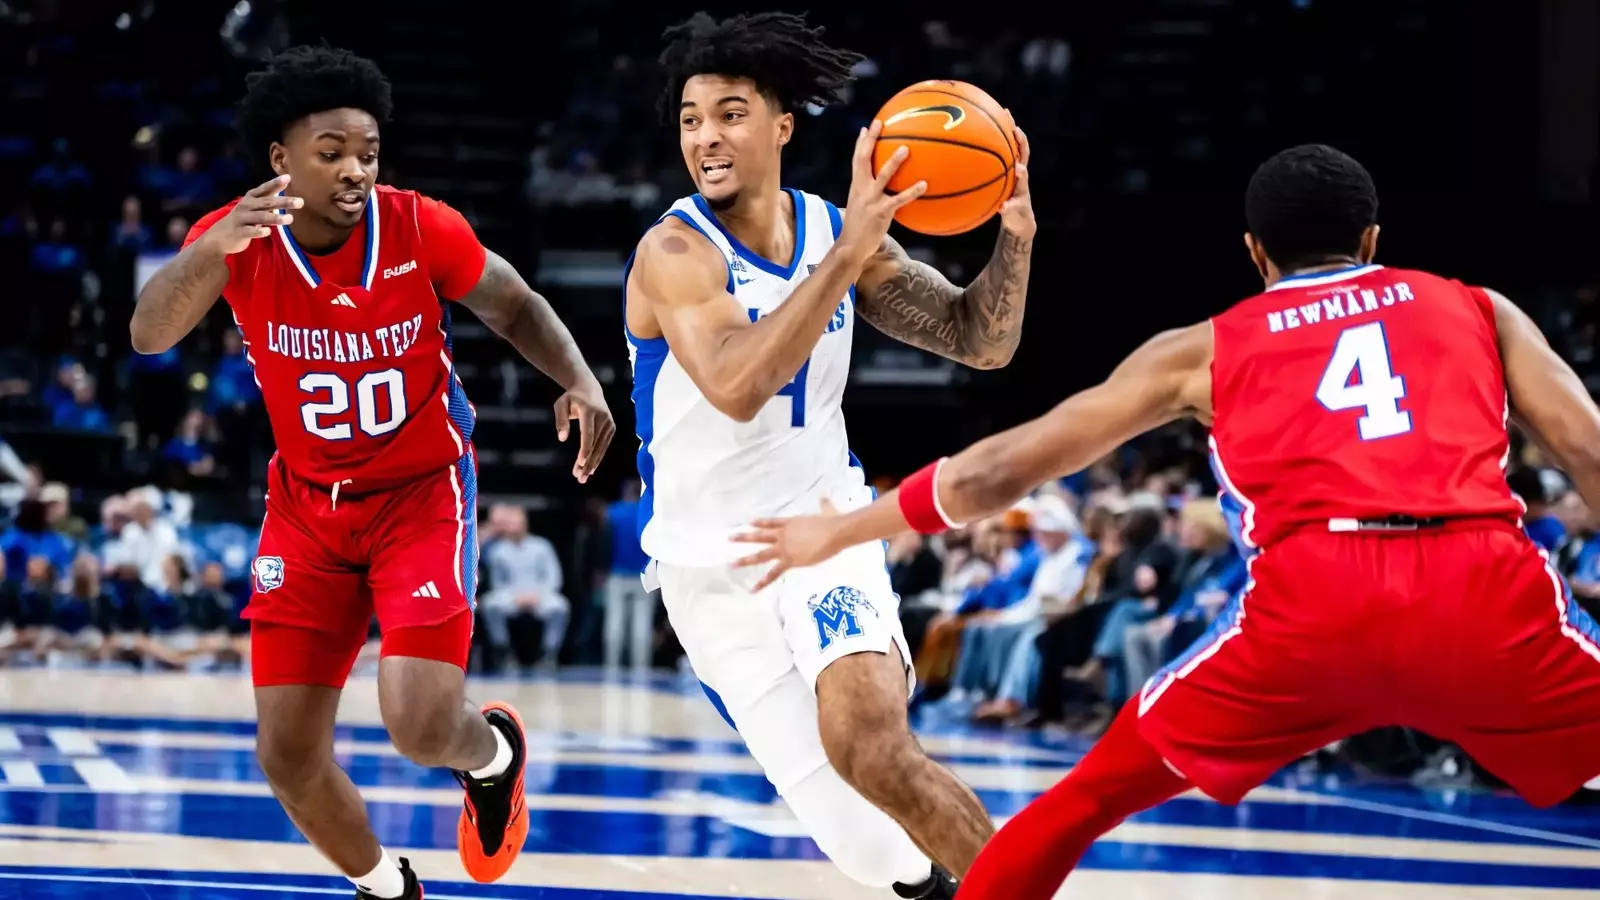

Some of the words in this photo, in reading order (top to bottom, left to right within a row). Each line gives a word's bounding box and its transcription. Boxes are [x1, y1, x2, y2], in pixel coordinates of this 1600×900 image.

[267, 320, 375, 363] LOUISIANA
[375, 313, 423, 357] TECH
[877, 282, 958, 352] Haggerty
[1267, 289, 1378, 333] NEWMAN
[1382, 282, 1415, 306] JR
[298, 367, 408, 441] 20
[1315, 320, 1414, 441] 4
